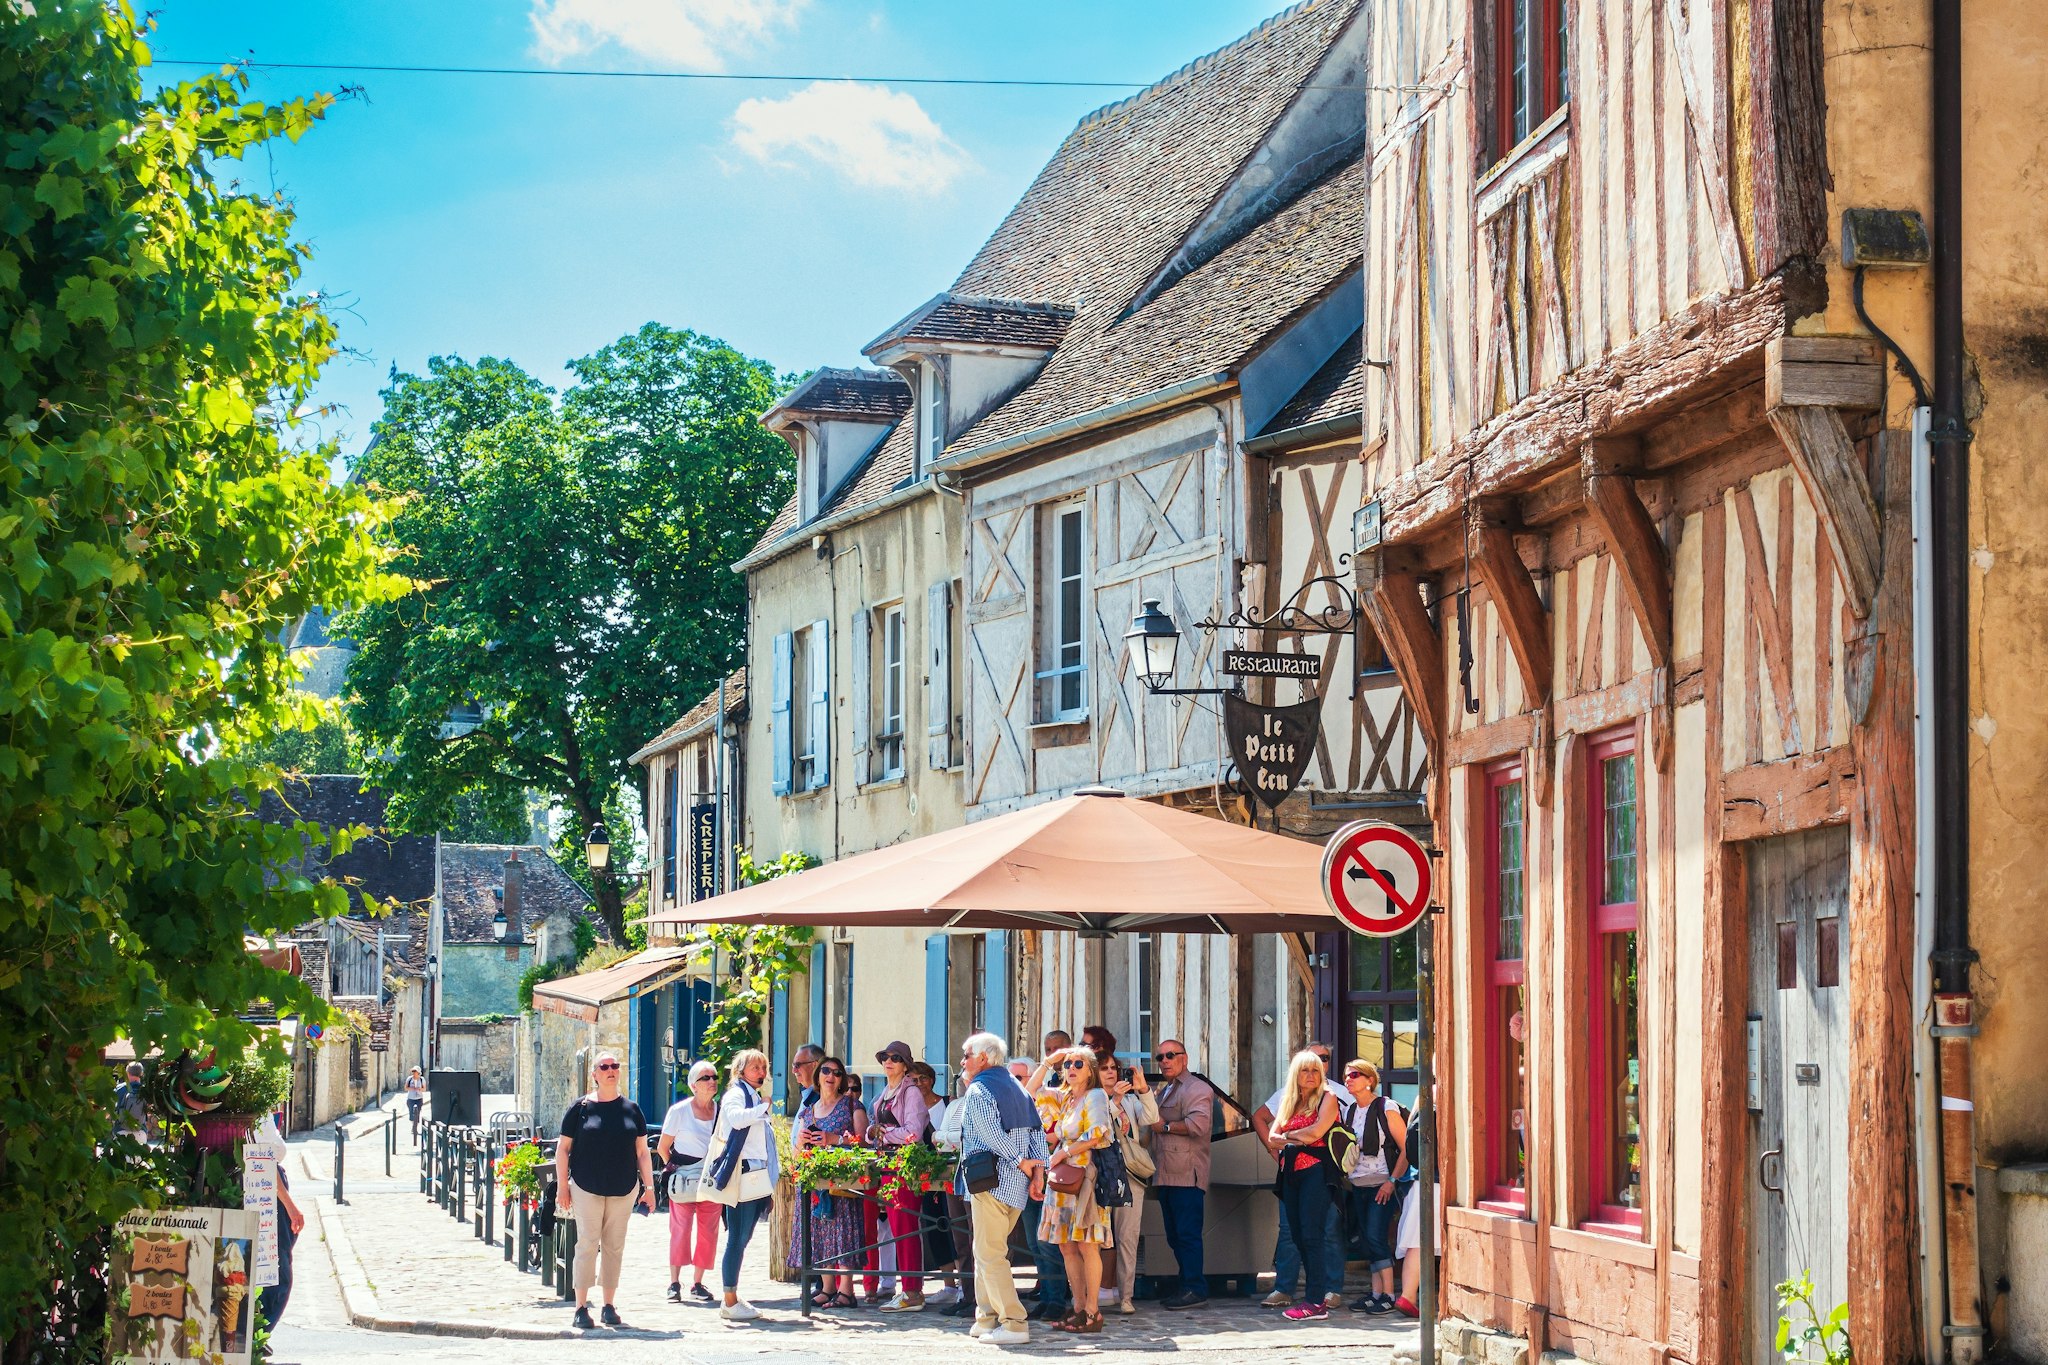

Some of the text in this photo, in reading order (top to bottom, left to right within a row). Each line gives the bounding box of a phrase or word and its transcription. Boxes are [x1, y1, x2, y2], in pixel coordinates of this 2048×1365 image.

[1245, 734, 1295, 763] Petit
[151, 1215, 208, 1230] artisanale
[145, 1289, 151, 1298] 2
